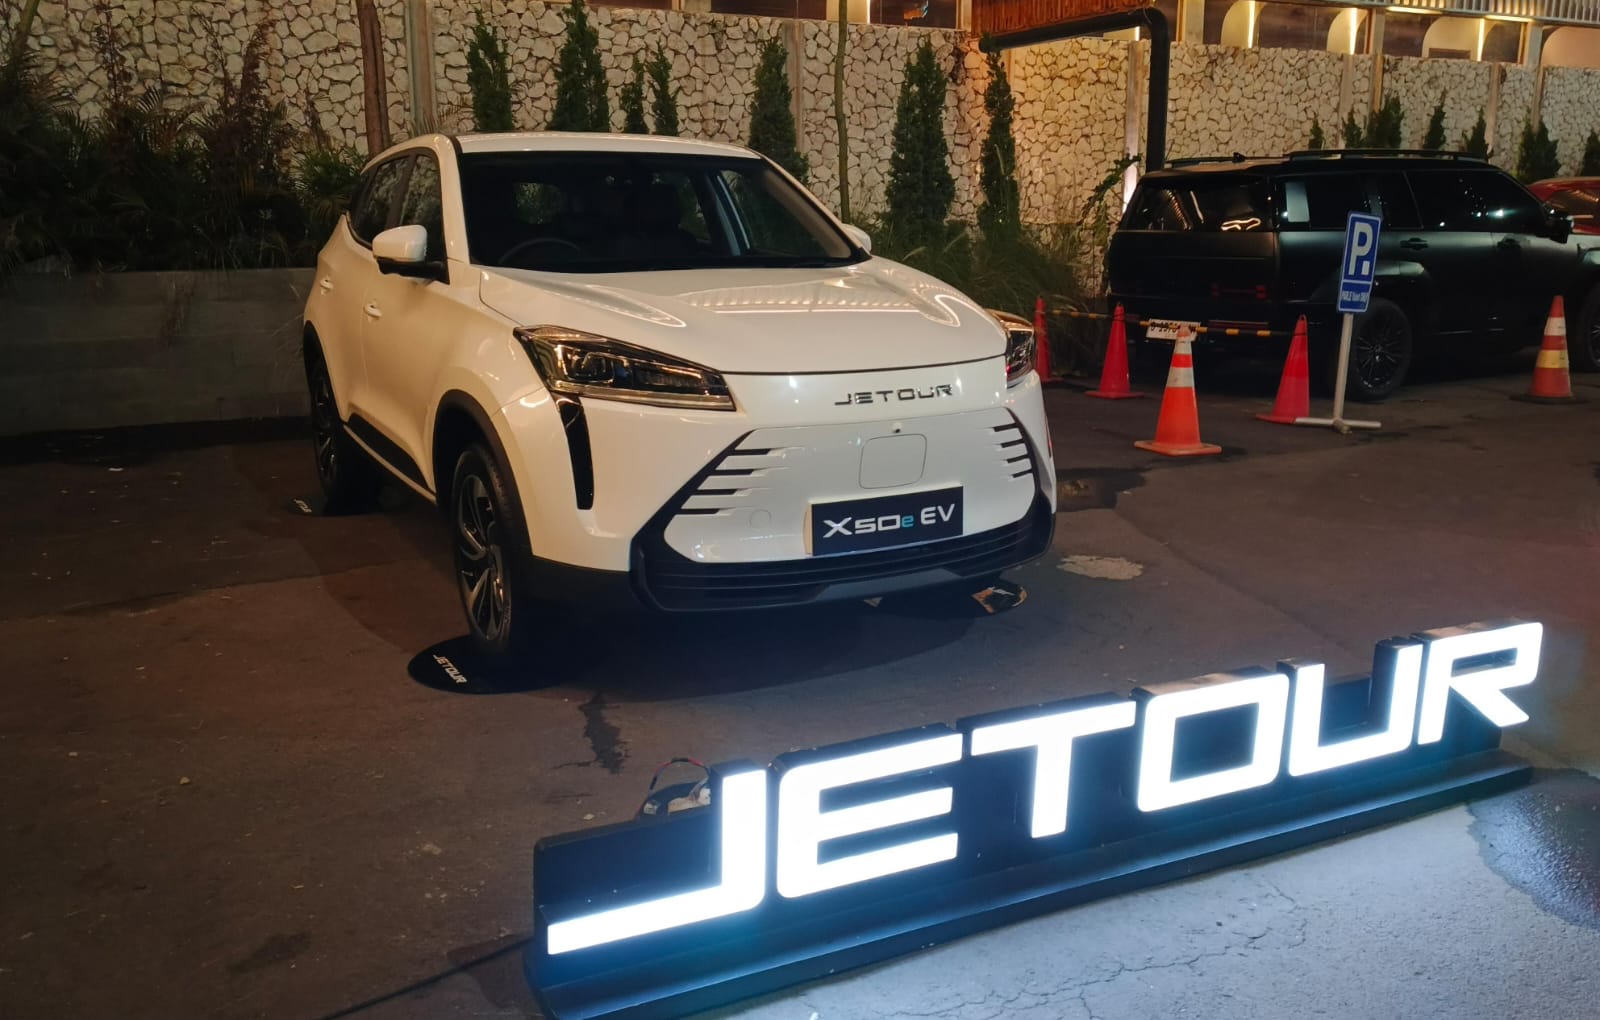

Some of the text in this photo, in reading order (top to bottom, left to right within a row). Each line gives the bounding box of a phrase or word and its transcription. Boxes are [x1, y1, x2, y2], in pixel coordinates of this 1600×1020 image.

[834, 384, 953, 406] JETOUR
[823, 503, 955, 538] X50e EV
[432, 654, 468, 684] JETOUR
[548, 623, 1542, 954] JETOUR
